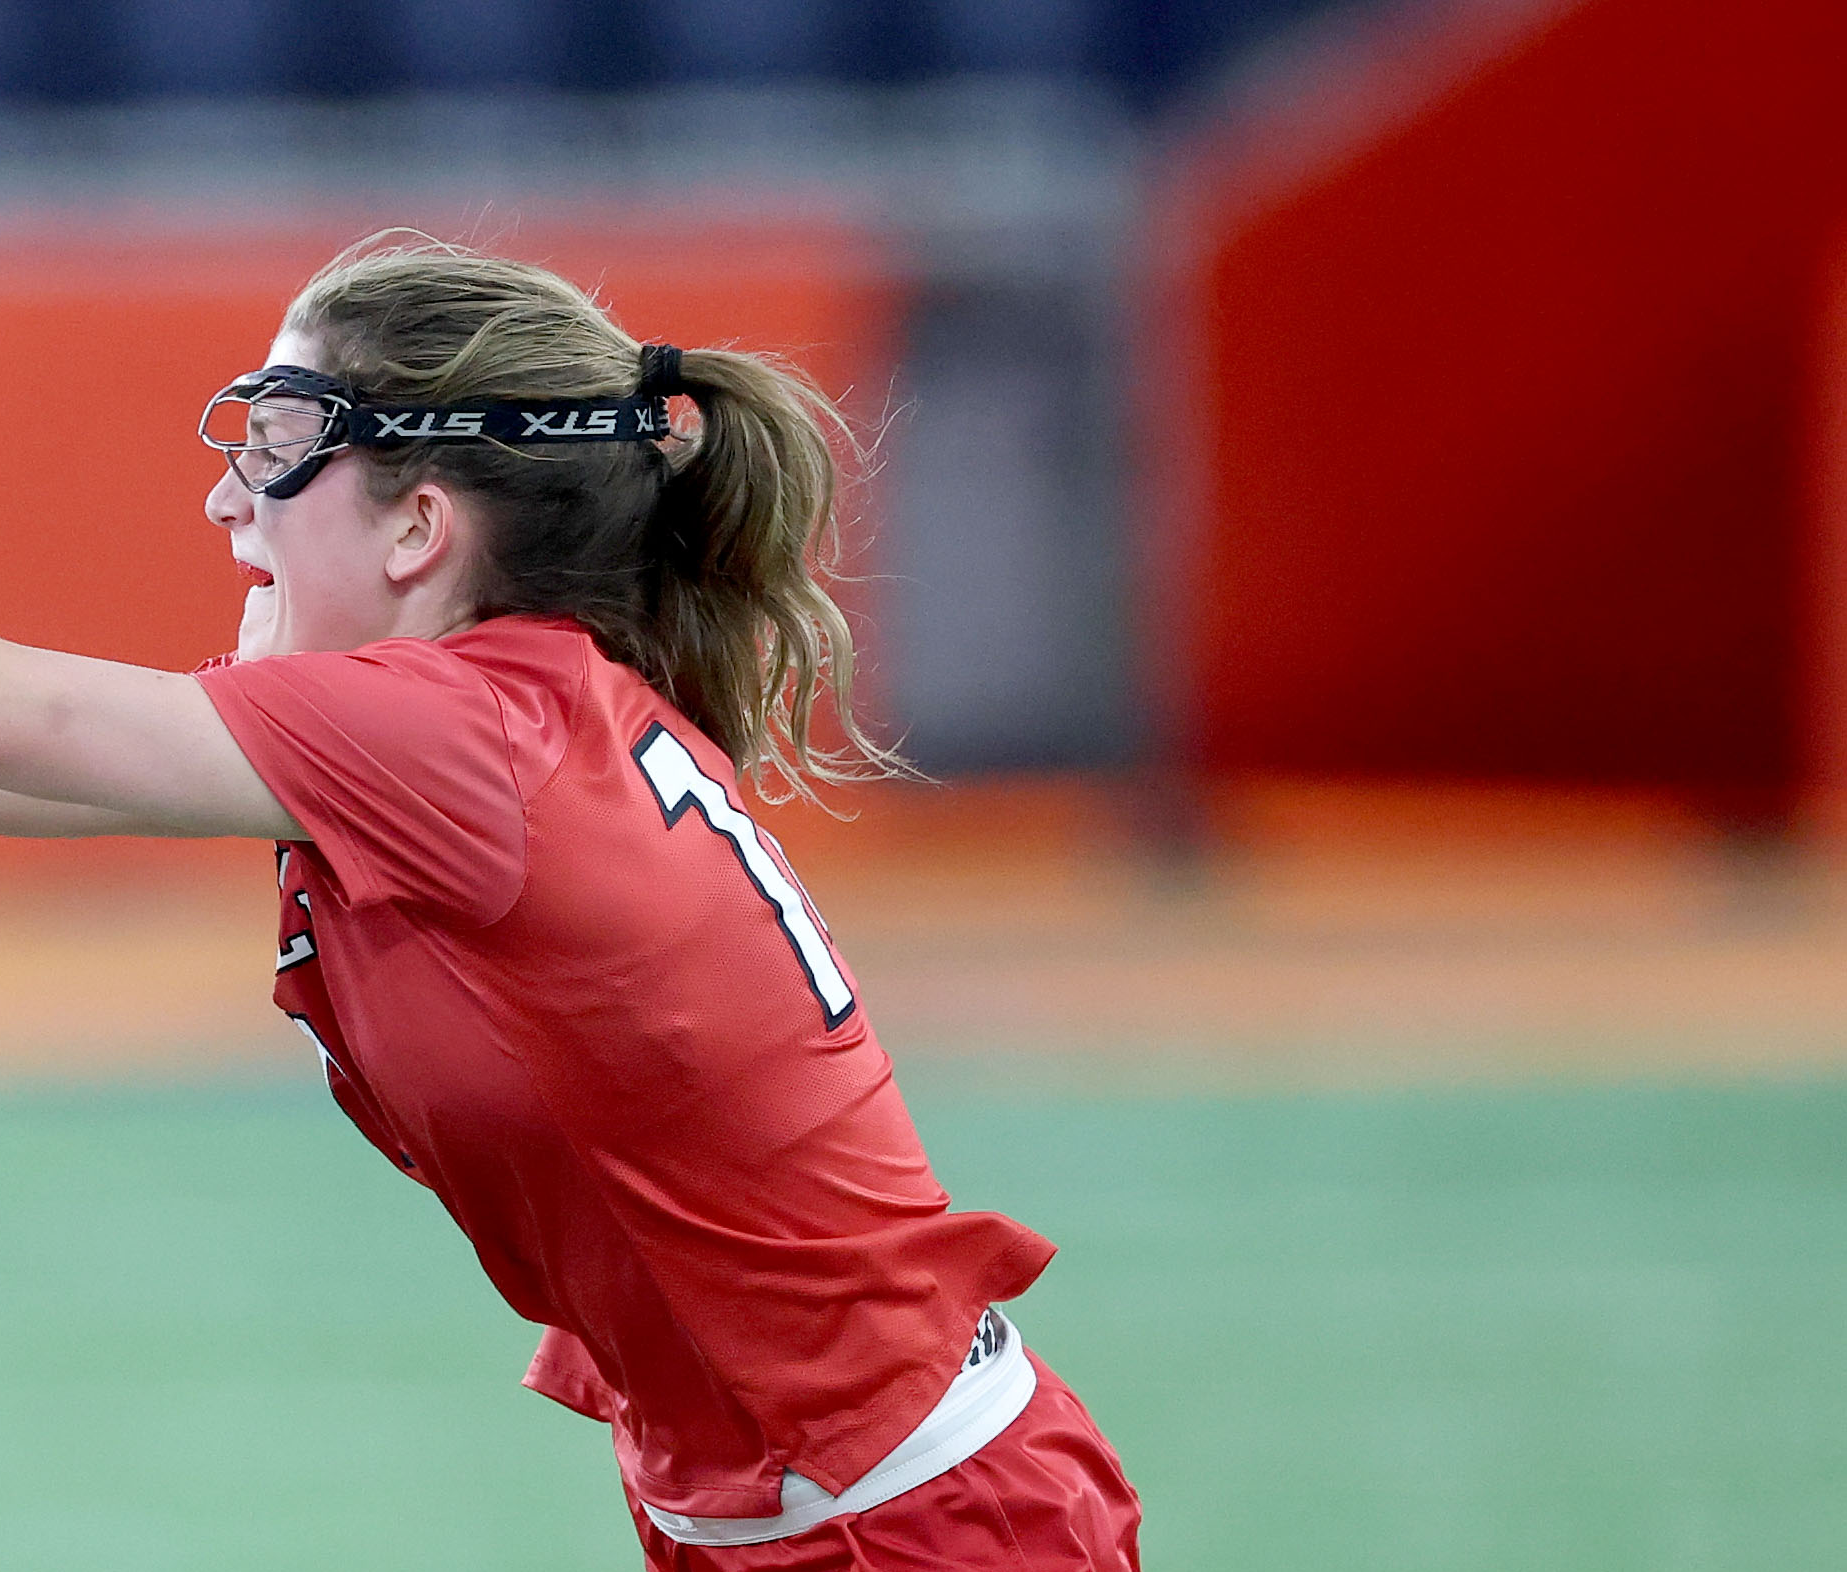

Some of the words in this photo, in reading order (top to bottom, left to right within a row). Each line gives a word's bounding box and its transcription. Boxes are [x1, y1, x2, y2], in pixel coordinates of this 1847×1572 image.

[373, 412, 486, 437] STX
[520, 409, 619, 436] STX
[632, 719, 855, 1032] 1
